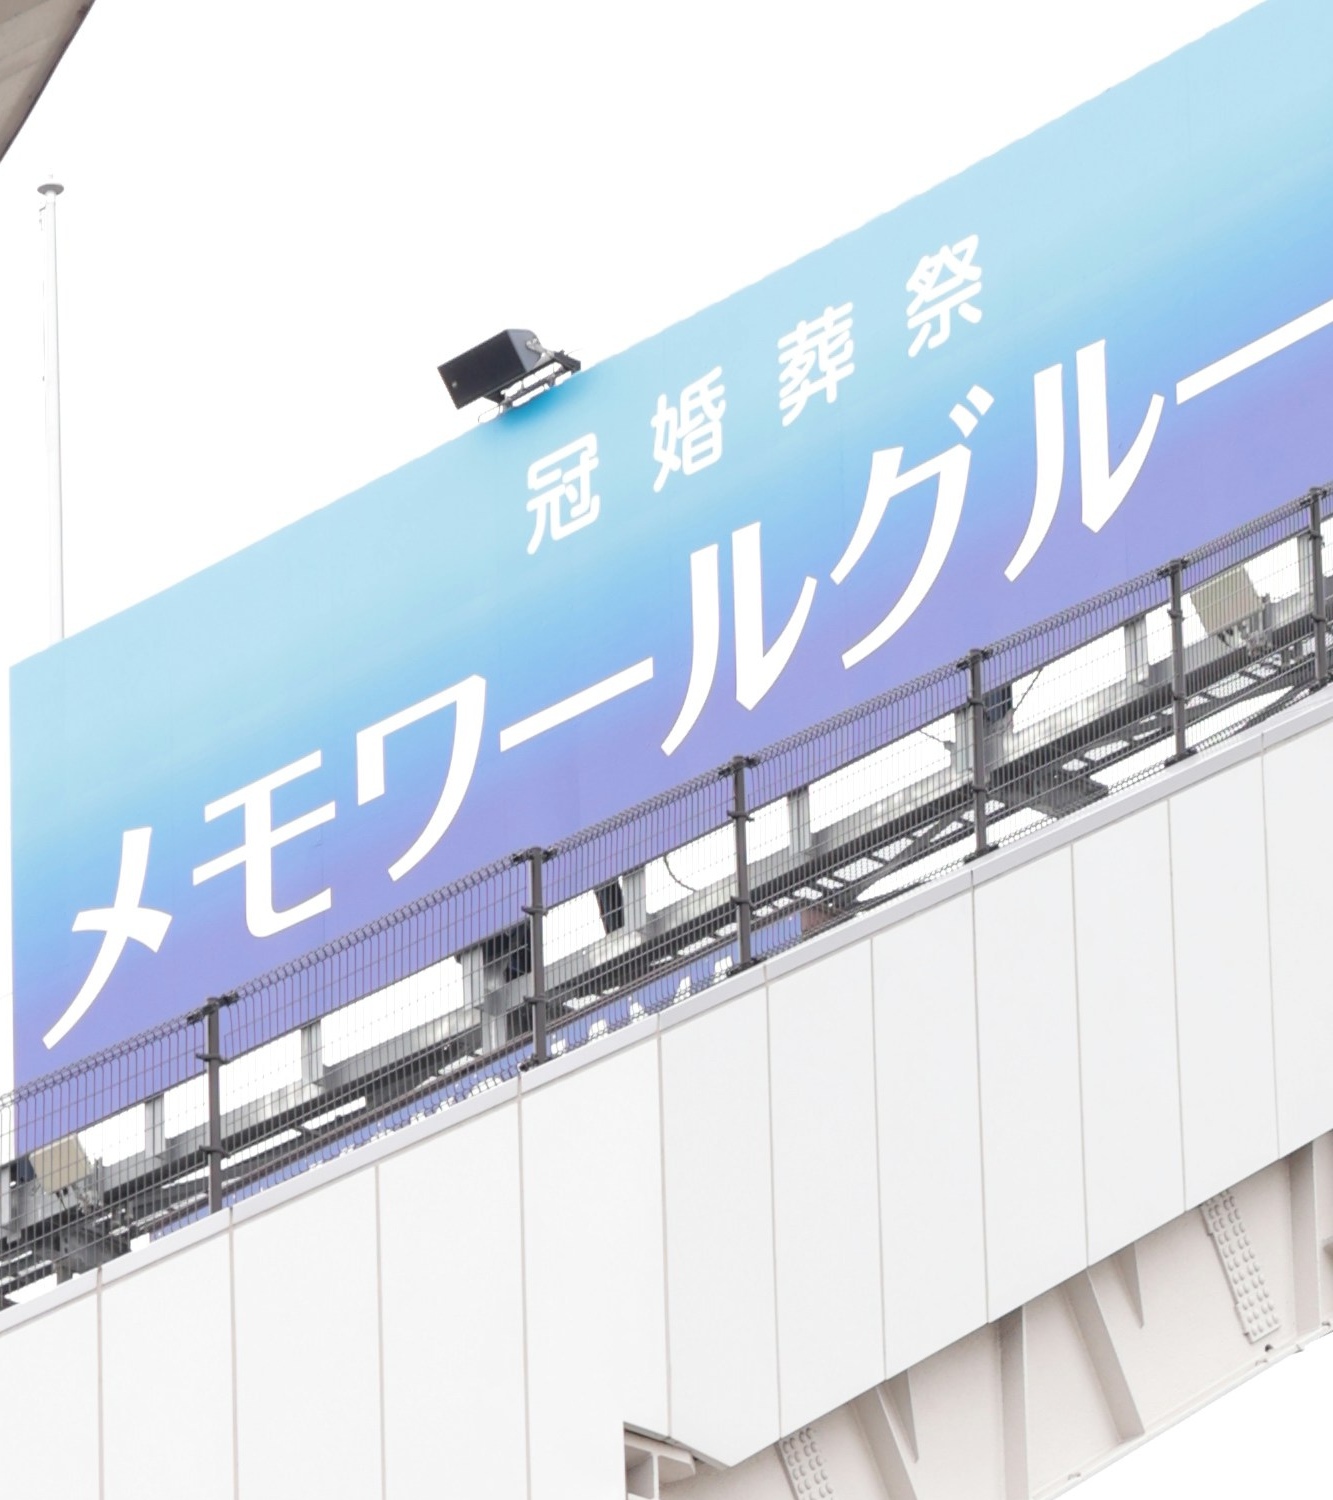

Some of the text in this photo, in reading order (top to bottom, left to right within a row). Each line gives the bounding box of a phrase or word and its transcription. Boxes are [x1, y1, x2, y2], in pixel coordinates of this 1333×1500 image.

[526, 233, 983, 555] 冠婚葬祭
[41, 298, 1333, 1049] メモワールグルー
